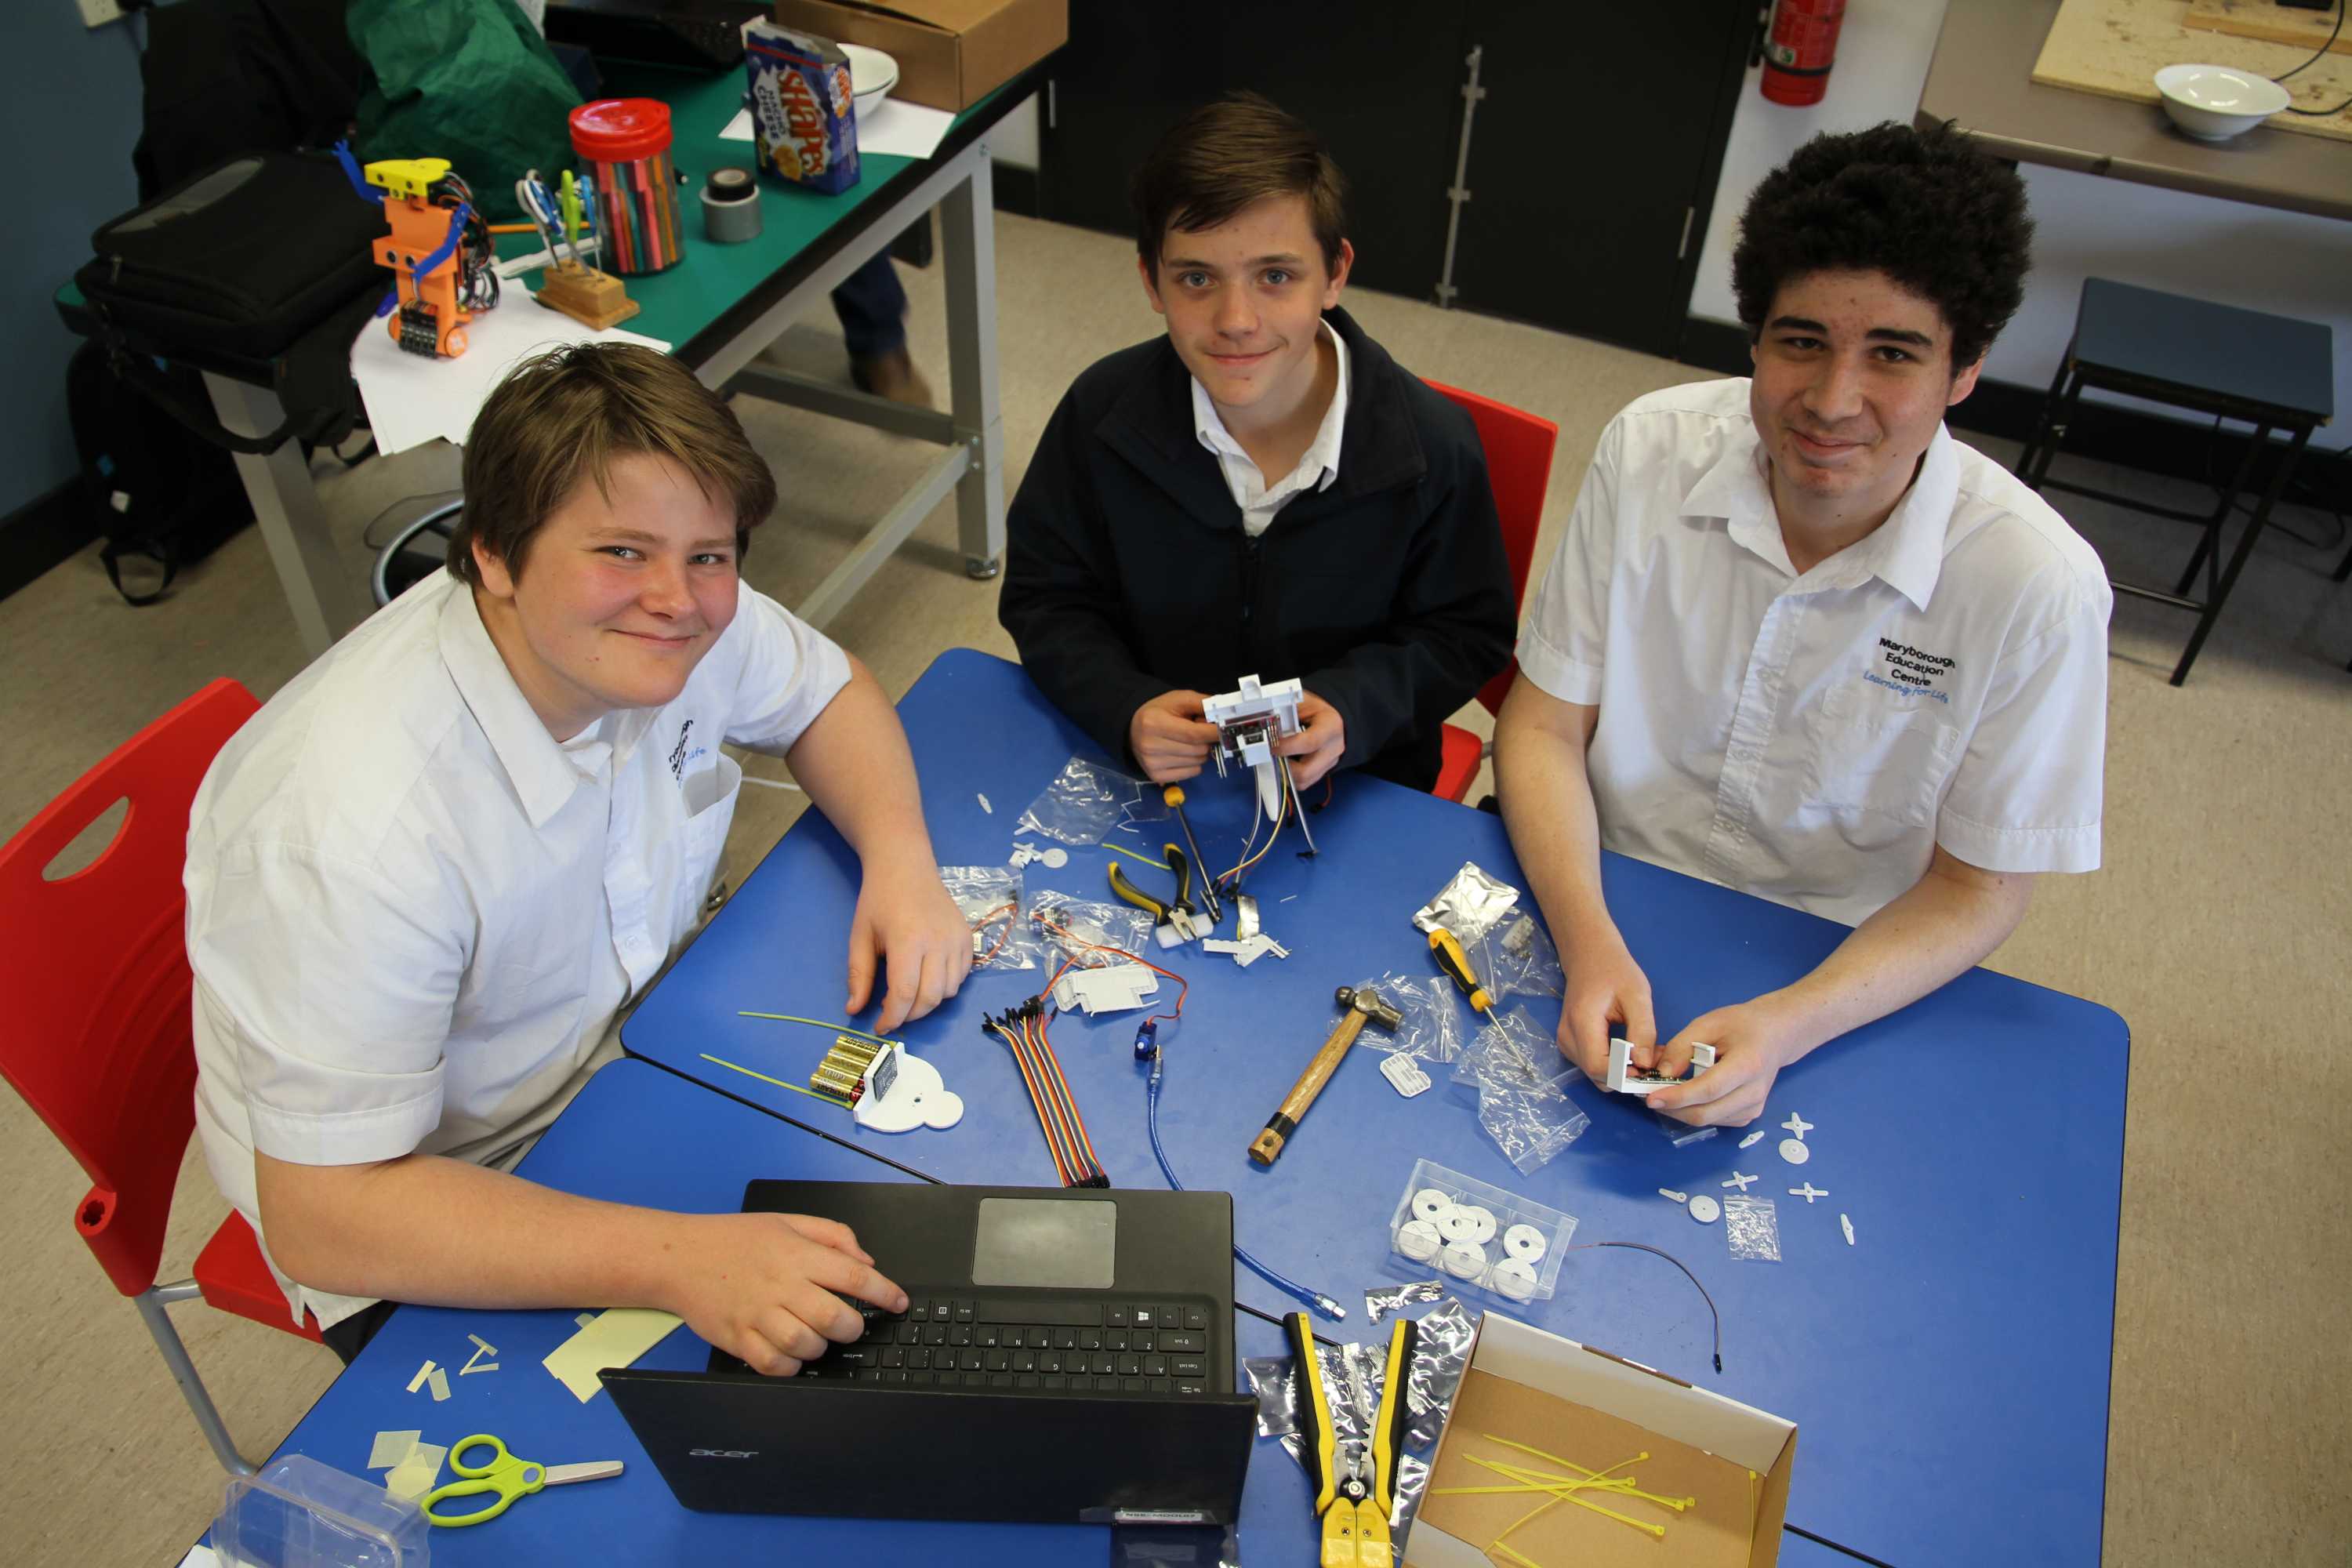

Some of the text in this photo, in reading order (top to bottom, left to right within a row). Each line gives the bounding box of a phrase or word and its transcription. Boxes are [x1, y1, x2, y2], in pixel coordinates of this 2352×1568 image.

[757, 85, 779, 140] CHEESE
[1879, 637, 1955, 668] Maryborough
[1886, 652, 1944, 676] Education
[1863, 670, 1949, 704] Learning for Life
[1891, 669, 1932, 686] Centre
[688, 1449, 760, 1458] acer
